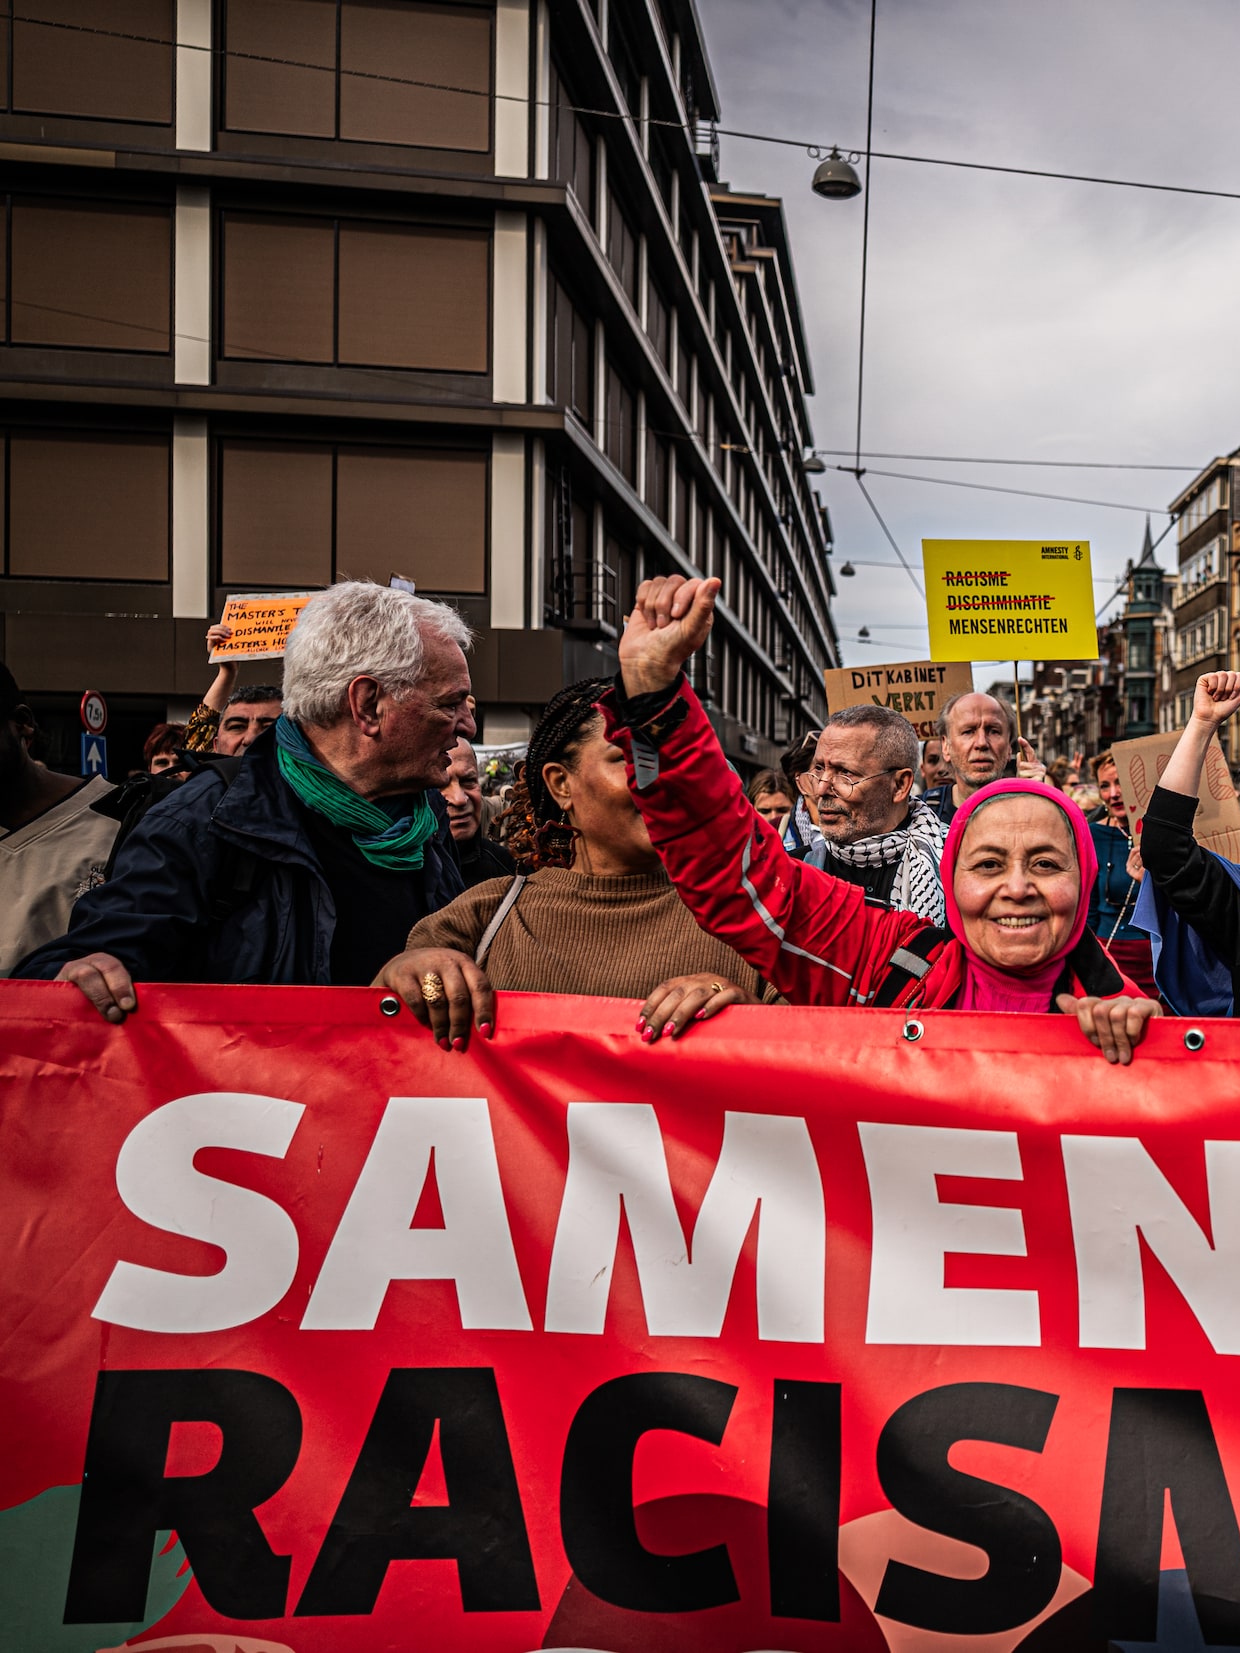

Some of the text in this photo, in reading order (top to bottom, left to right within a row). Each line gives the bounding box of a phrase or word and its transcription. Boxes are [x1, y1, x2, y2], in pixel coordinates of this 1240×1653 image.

[1041, 546, 1068, 554] AMNESTY
[946, 571, 1008, 586] RACISME
[947, 595, 1051, 610] DISCRIMINATIE
[227, 609, 286, 621] MASTER'S
[235, 623, 291, 637] DISMANTLE
[949, 618, 1068, 634] MENSENRECHTEN
